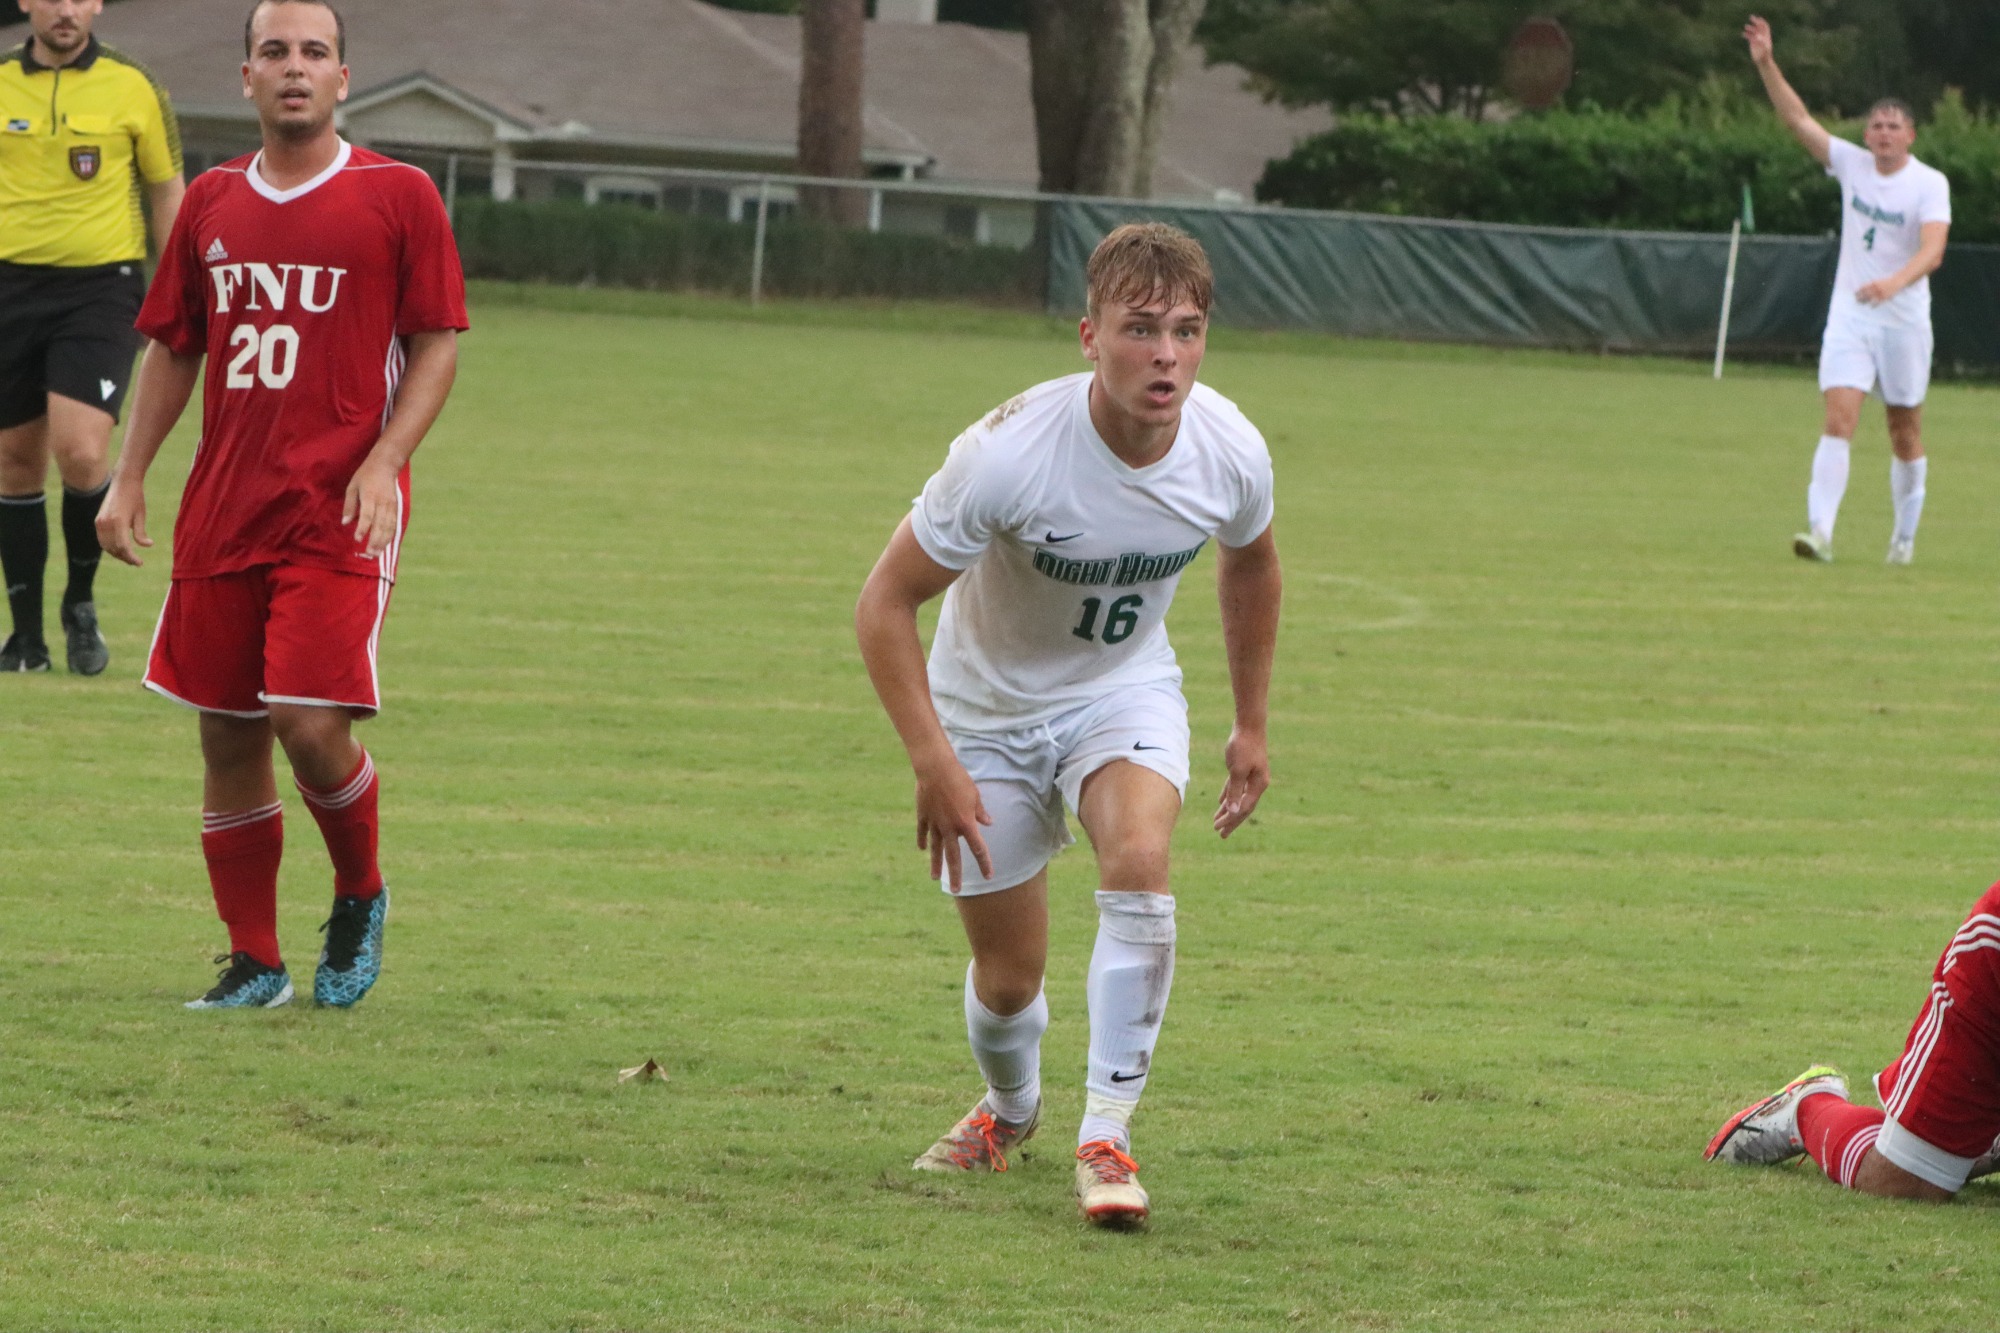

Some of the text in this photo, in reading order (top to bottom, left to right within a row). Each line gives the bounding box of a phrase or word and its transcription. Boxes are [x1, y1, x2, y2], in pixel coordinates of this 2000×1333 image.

[1863, 225, 1875, 251] 4
[209, 262, 347, 313] FNU
[227, 324, 299, 389] 20
[1072, 594, 1143, 645] 16
